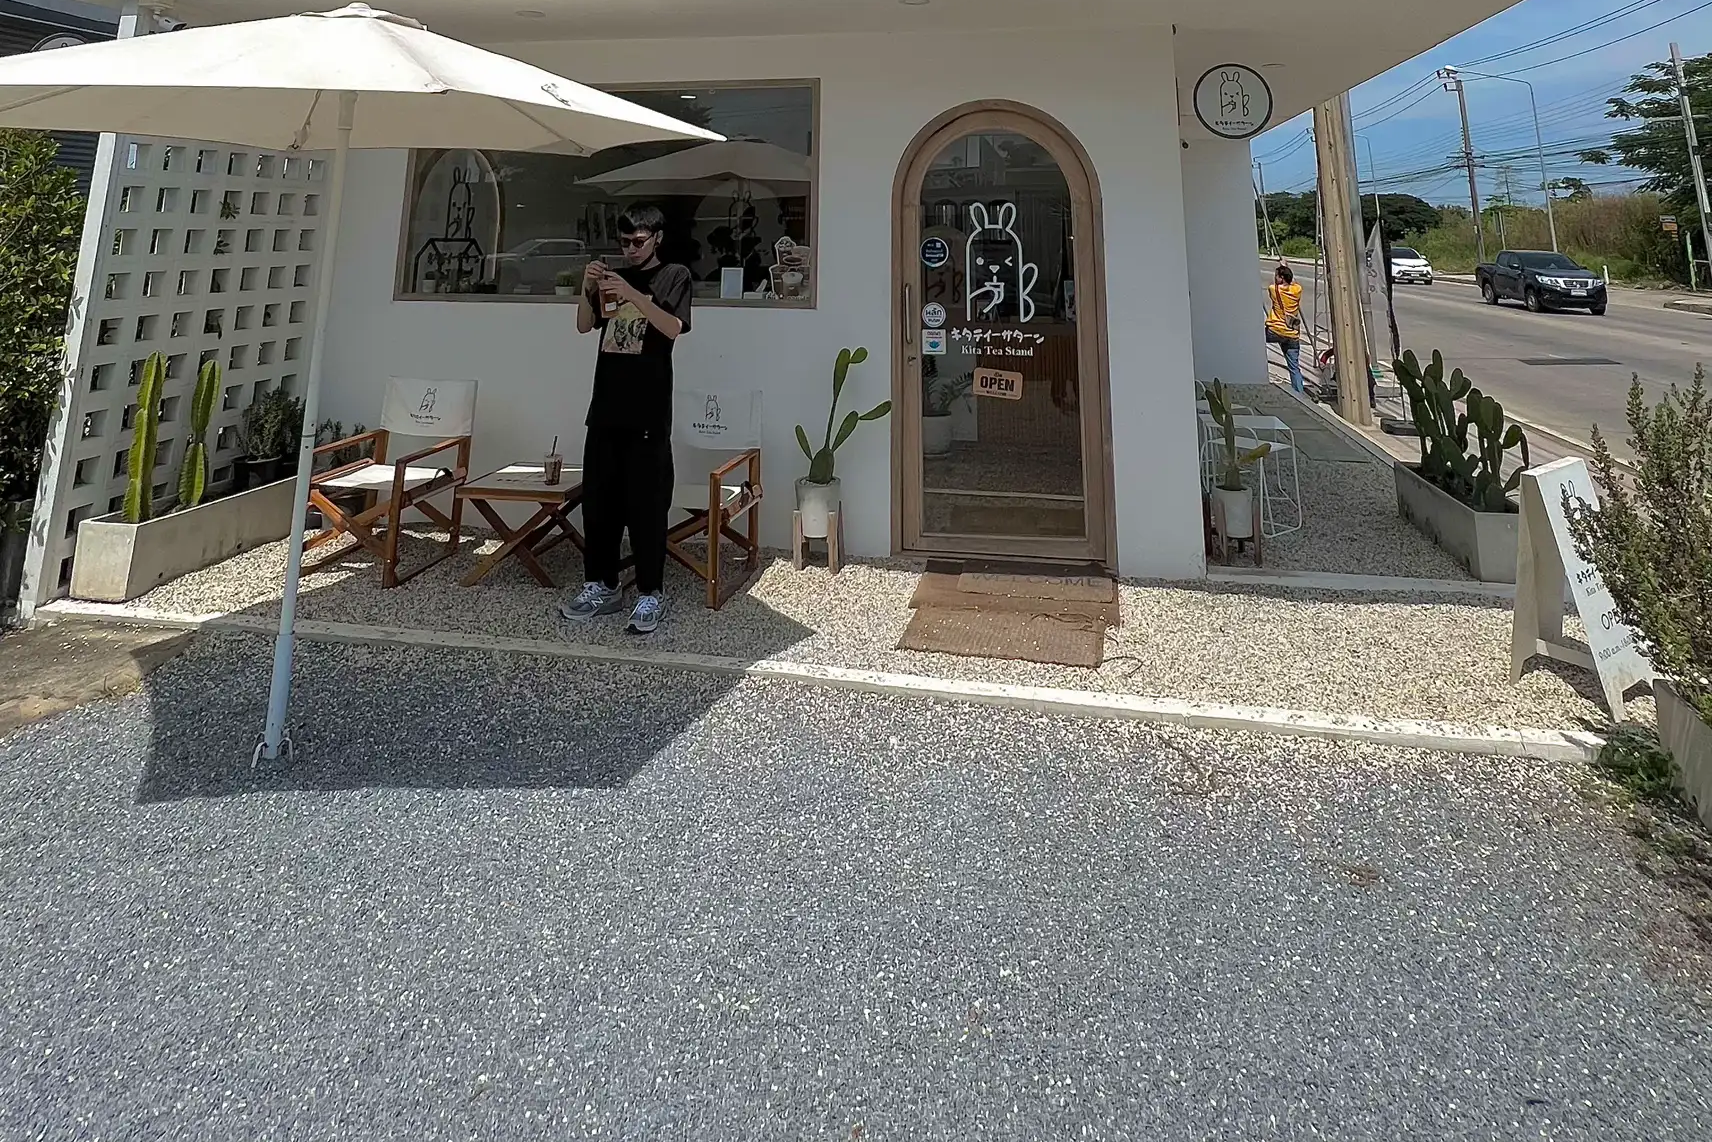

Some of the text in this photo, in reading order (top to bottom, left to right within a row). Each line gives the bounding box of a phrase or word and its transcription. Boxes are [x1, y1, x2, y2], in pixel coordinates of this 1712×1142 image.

[961, 345, 1034, 357] Kita Tea Stand
[979, 375, 1015, 392] OPEN
[1601, 607, 1623, 630] OPE
